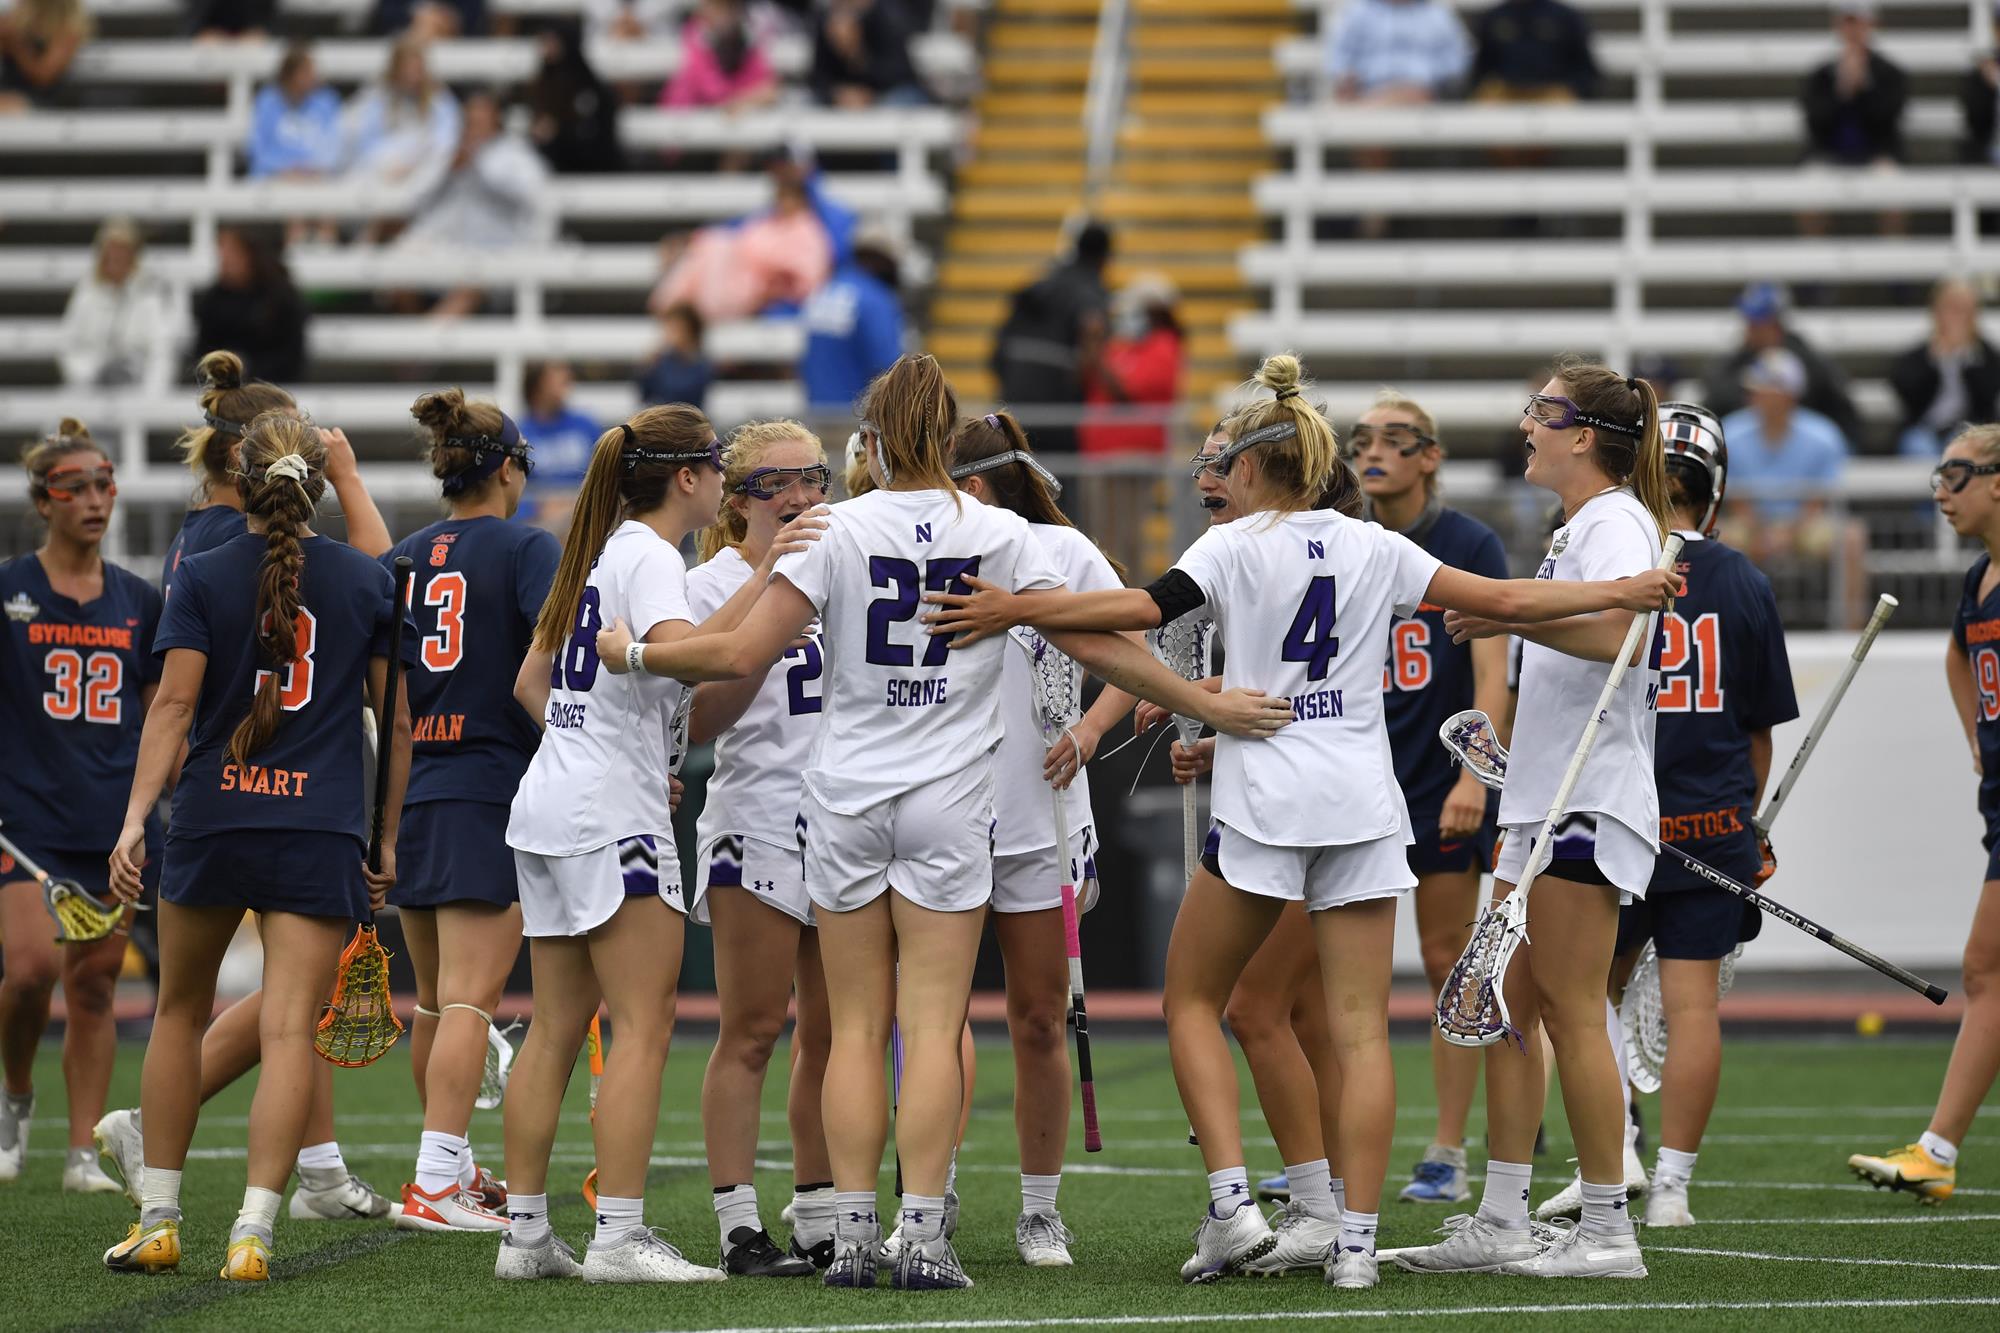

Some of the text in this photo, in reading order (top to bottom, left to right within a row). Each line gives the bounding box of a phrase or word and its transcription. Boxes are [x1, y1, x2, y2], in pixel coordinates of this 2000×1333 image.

[429, 543, 449, 567] S
[915, 522, 933, 543] N
[1307, 539, 1325, 560] N
[28, 623, 133, 651] SYRACUSE
[865, 554, 983, 668] 27
[1281, 574, 1340, 682] 4
[43, 647, 123, 725] 32
[784, 634, 825, 716] 2
[1656, 611, 1725, 713] 21
[1969, 647, 2000, 722] 9
[886, 677, 948, 707] SCANE
[1284, 689, 1343, 723] NSEN
[220, 764, 309, 797] SWART
[1683, 859, 1820, 937] UNDER ARMOUR
